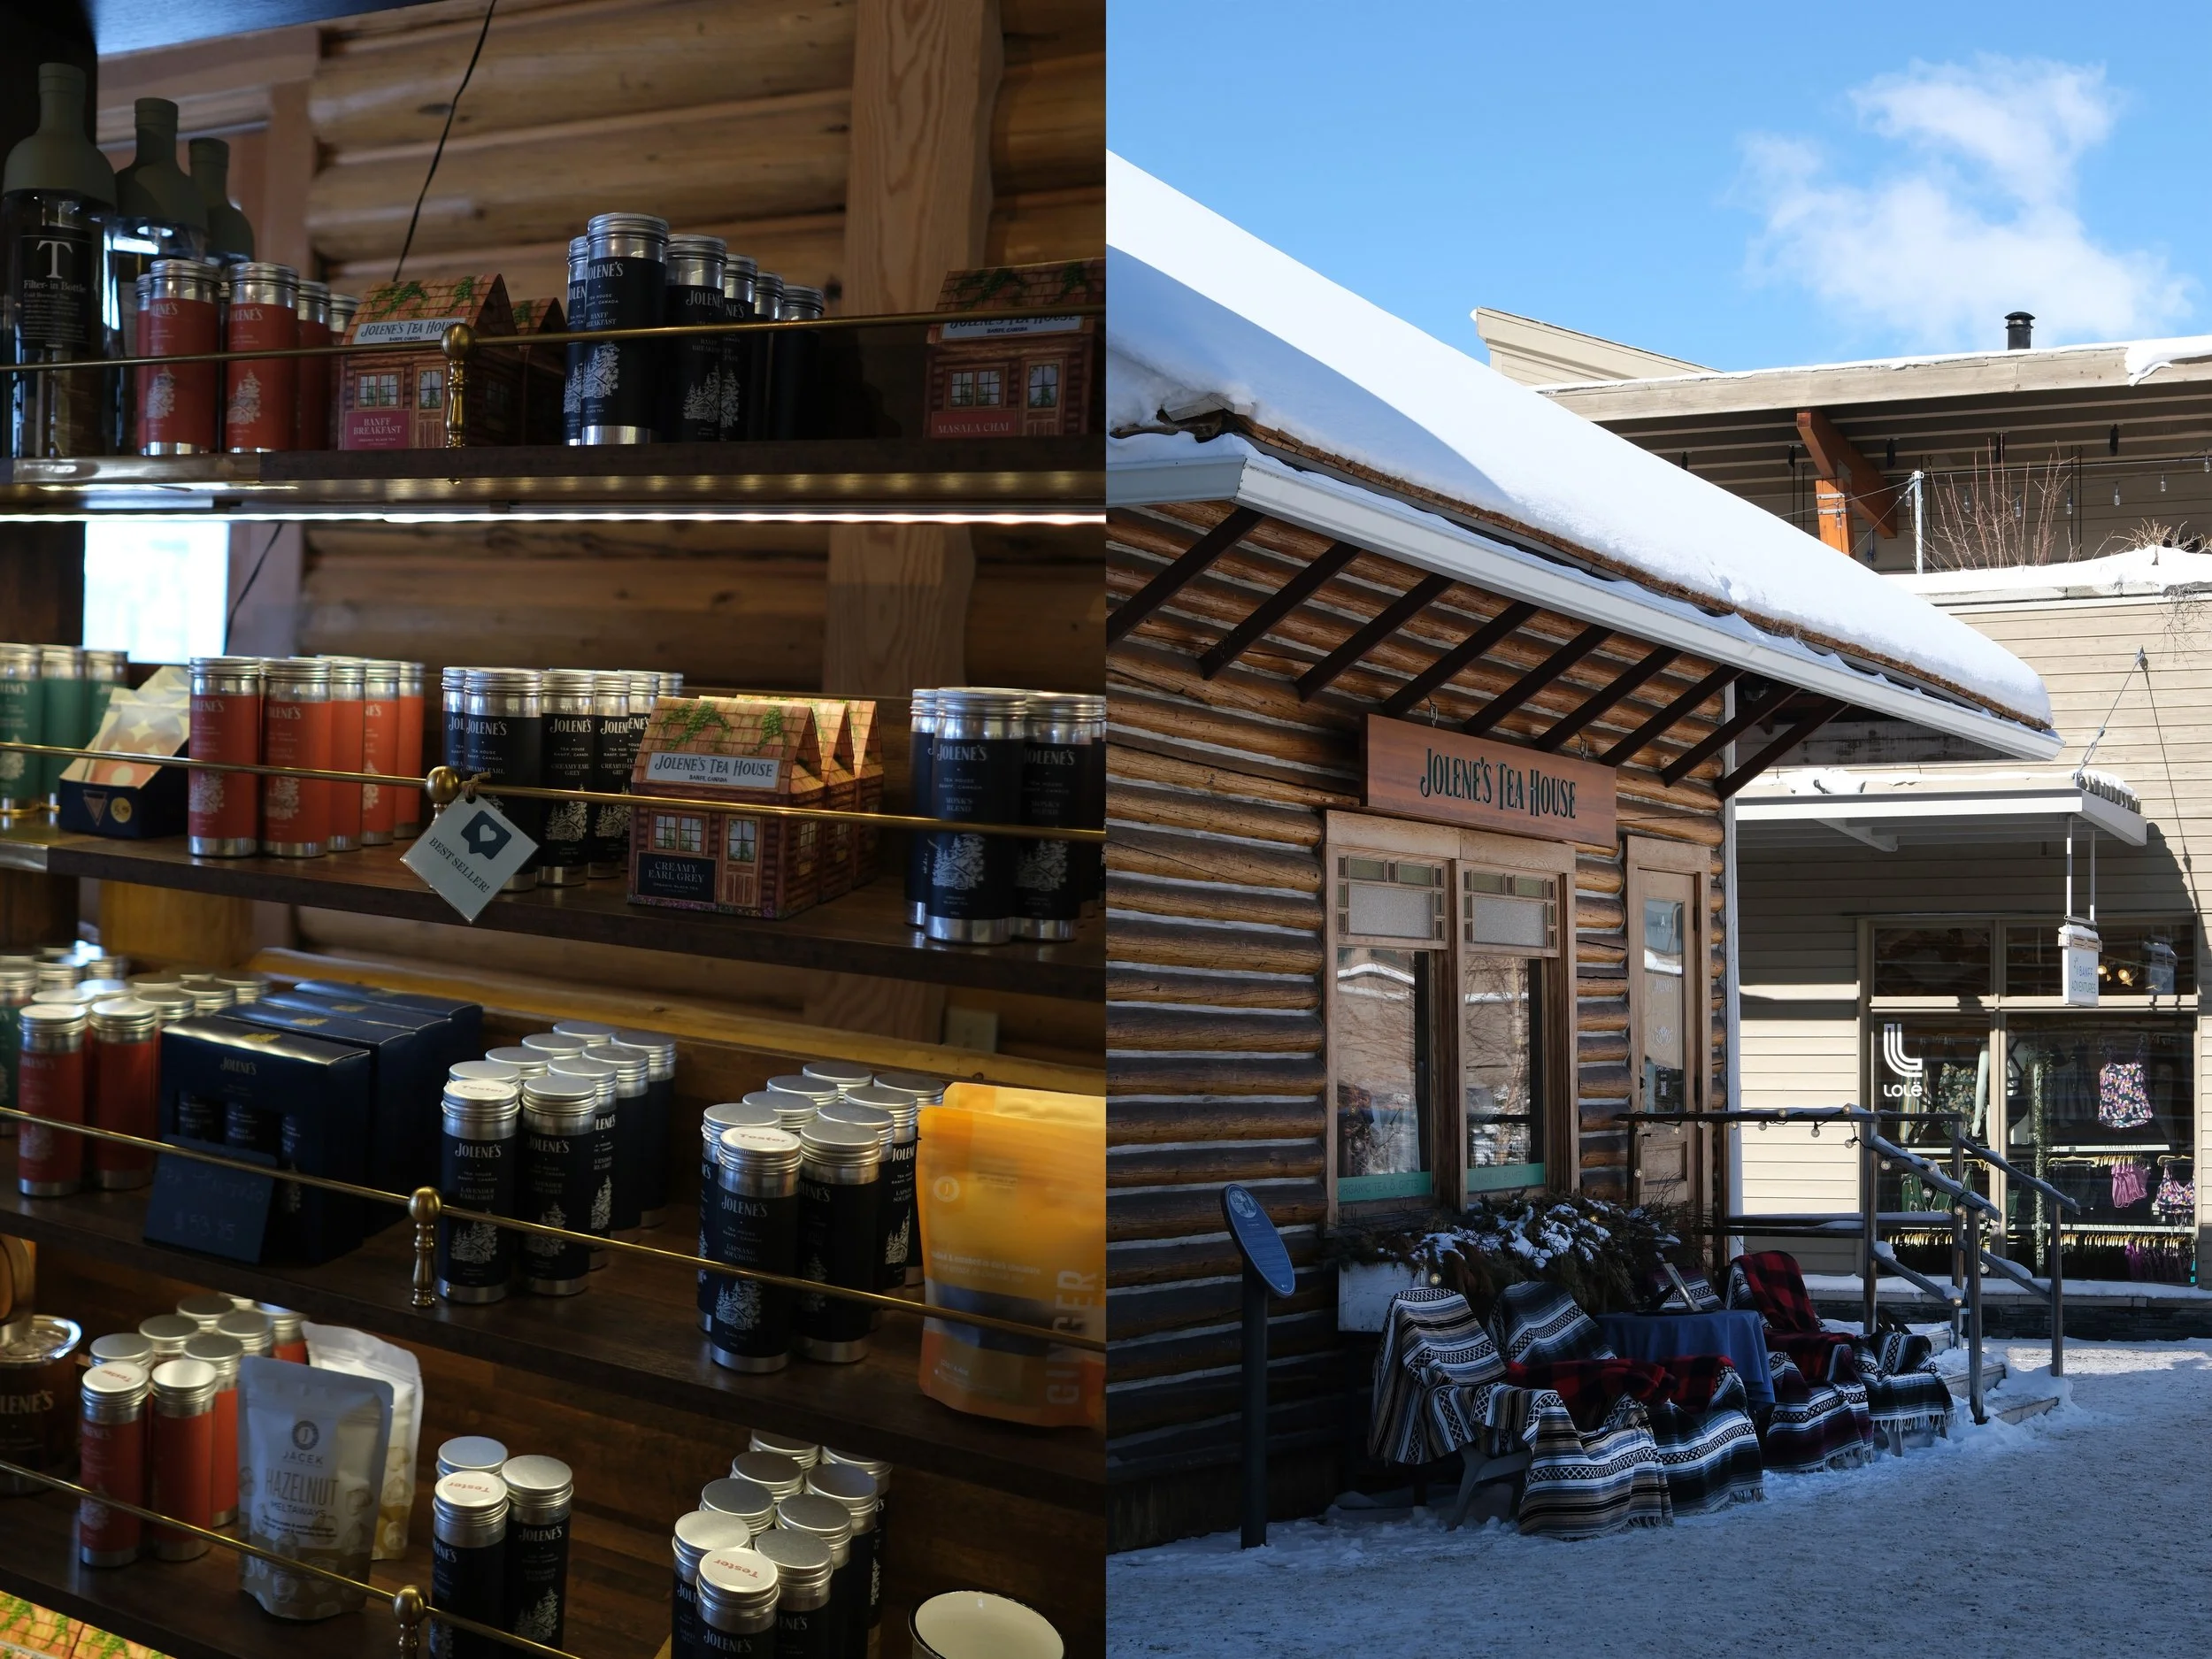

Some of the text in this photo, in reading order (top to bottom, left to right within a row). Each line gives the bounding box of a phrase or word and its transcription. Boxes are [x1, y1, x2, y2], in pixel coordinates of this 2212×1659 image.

[36, 240, 73, 280] T
[588, 261, 624, 280] OLENE'S
[50, 280, 59, 289] in
[726, 302, 745, 319] NE'S
[361, 321, 404, 337] JOLENE'S
[407, 321, 423, 335] TEA
[353, 425, 403, 435] BREAKFAST
[364, 418, 391, 426] BANFF
[937, 422, 1009, 434] MASALA CHAI
[466, 718, 507, 736] JOLENE'S
[549, 718, 592, 733] JOLENE'S
[628, 717, 649, 730] ENE'S
[937, 744, 988, 761] JOLENE'S
[655, 755, 774, 778] JOLENE'S TEA HOUSE
[1420, 748, 1577, 819] JOLENE'S TEA HOUSE
[428, 837, 490, 893] BEST SELLER!
[655, 861, 698, 873] CREAMY
[648, 869, 705, 883] EARL GREY
[595, 1114, 616, 1130] LENE'S
[455, 1142, 502, 1158] JOLENE'S
[721, 1195, 768, 1217] JOLENE'S
[0, 1390, 54, 1415] LENE'S
[283, 1452, 323, 1464] JACEK
[265, 1468, 338, 1507] HAZELNUT
[271, 1500, 326, 1520] MELTAWAYS
[518, 1525, 563, 1542] JOLENE'S
[713, 1558, 758, 1579] Tester
[780, 1616, 808, 1631] ENE'S
[703, 1629, 752, 1654] JOLENE'S
